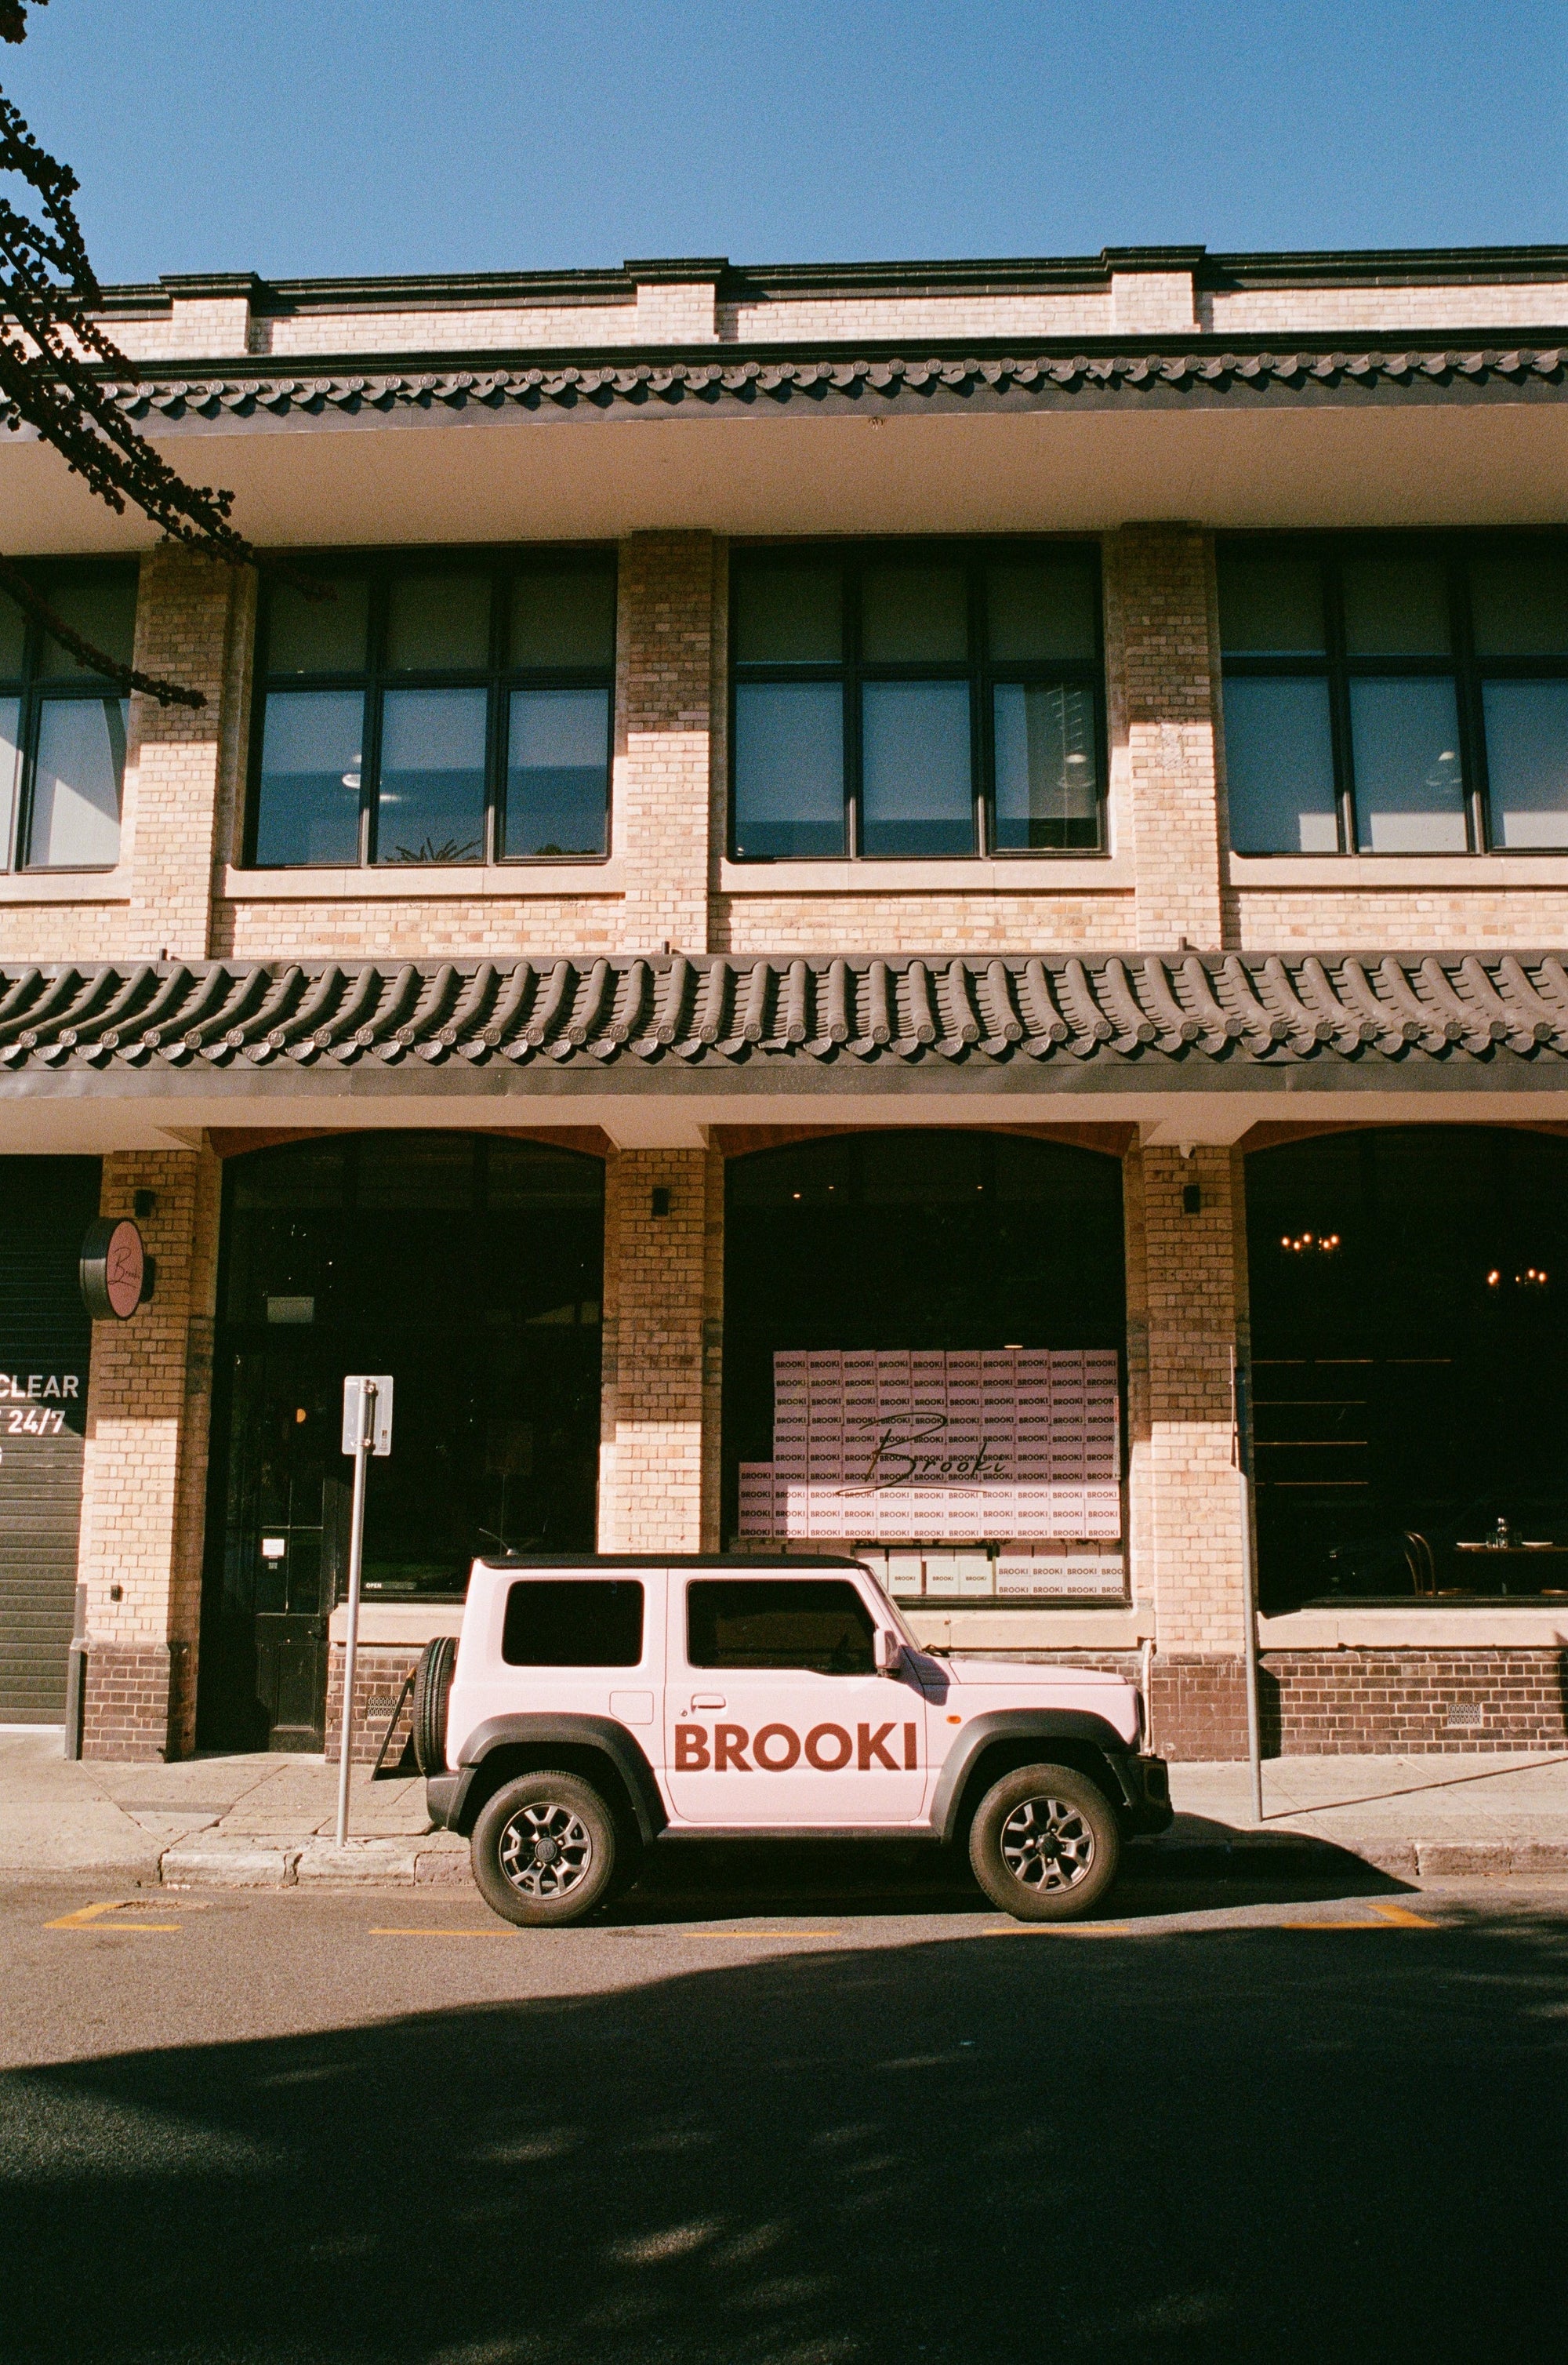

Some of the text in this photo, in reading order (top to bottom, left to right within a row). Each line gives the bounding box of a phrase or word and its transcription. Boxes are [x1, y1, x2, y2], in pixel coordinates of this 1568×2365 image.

[0, 1374, 78, 1397] CLEAR
[8, 1408, 66, 1435] 24/7
[836, 1412, 1006, 1496] Brooki
[675, 1723, 917, 1772] BROOKI
